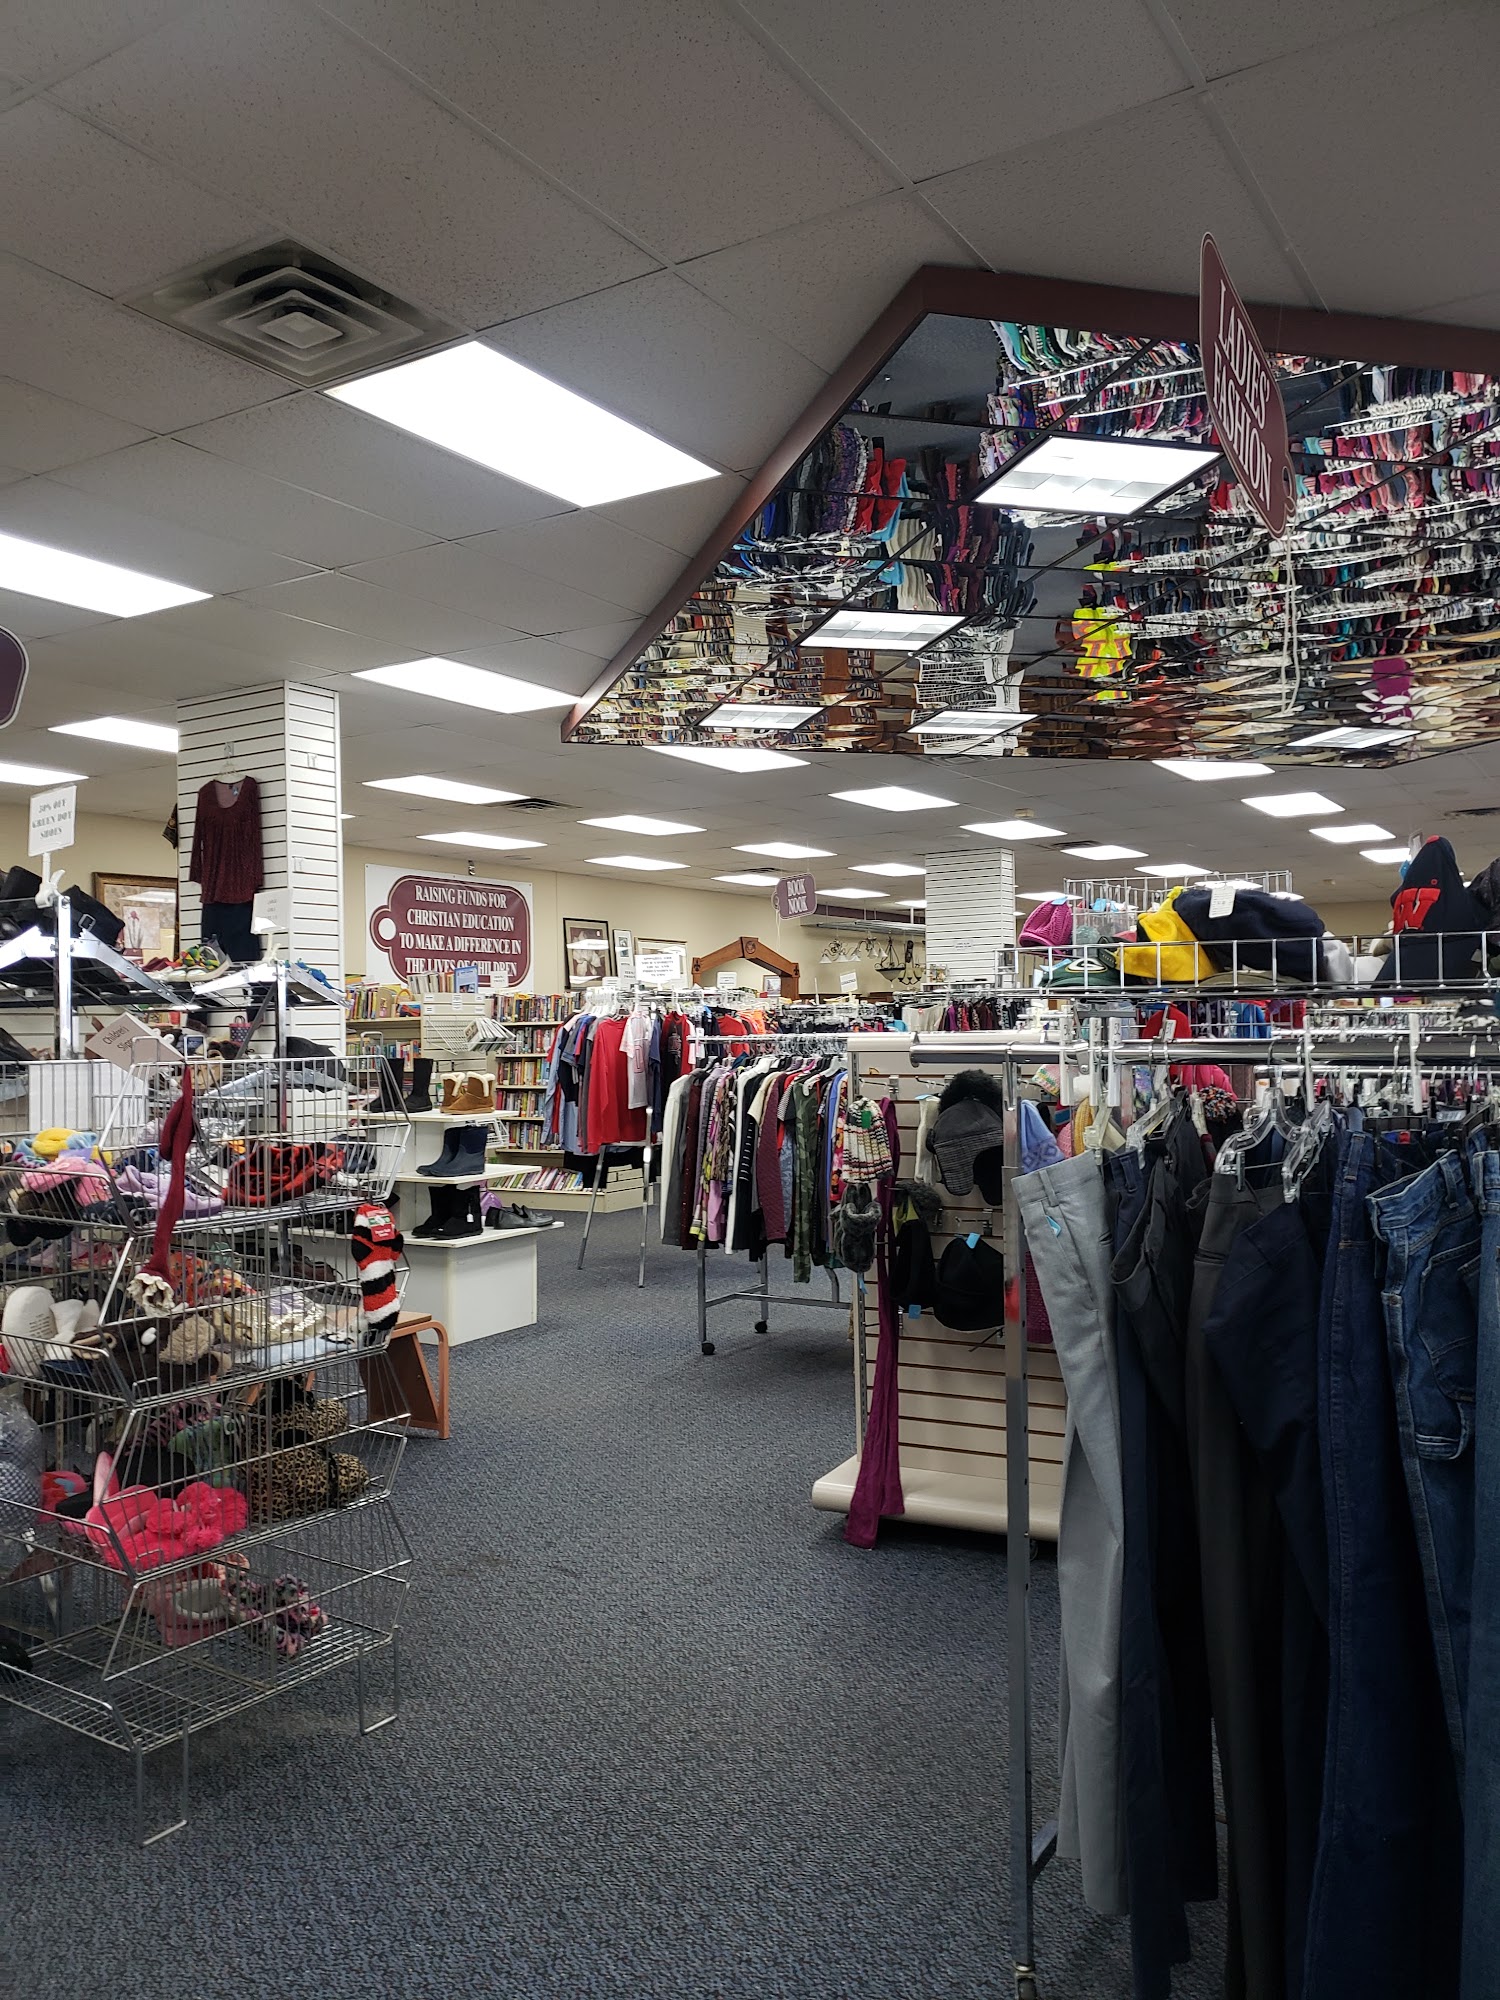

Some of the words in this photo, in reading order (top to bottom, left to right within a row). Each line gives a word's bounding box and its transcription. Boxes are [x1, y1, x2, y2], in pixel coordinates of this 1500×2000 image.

[1218, 279, 1270, 429] LADIES'
[1213, 342, 1272, 511] FASHION
[415, 885, 456, 904] RAISING
[457, 890, 488, 907] FUNDS
[489, 893, 507, 909] FOR
[787, 879, 806, 896] BOOK
[788, 896, 808, 914] NOOK
[1393, 888, 1440, 935] W
[407, 908, 460, 928] CHRISTIAN
[462, 913, 514, 931] EDUCATION
[399, 932, 414, 949] TO
[415, 934, 444, 951] MAKE
[446, 936, 453, 951] A
[454, 937, 510, 954] DIFFERENCE
[511, 940, 522, 955] IN
[404, 957, 425, 974] THE
[427, 959, 456, 975] LIVES
